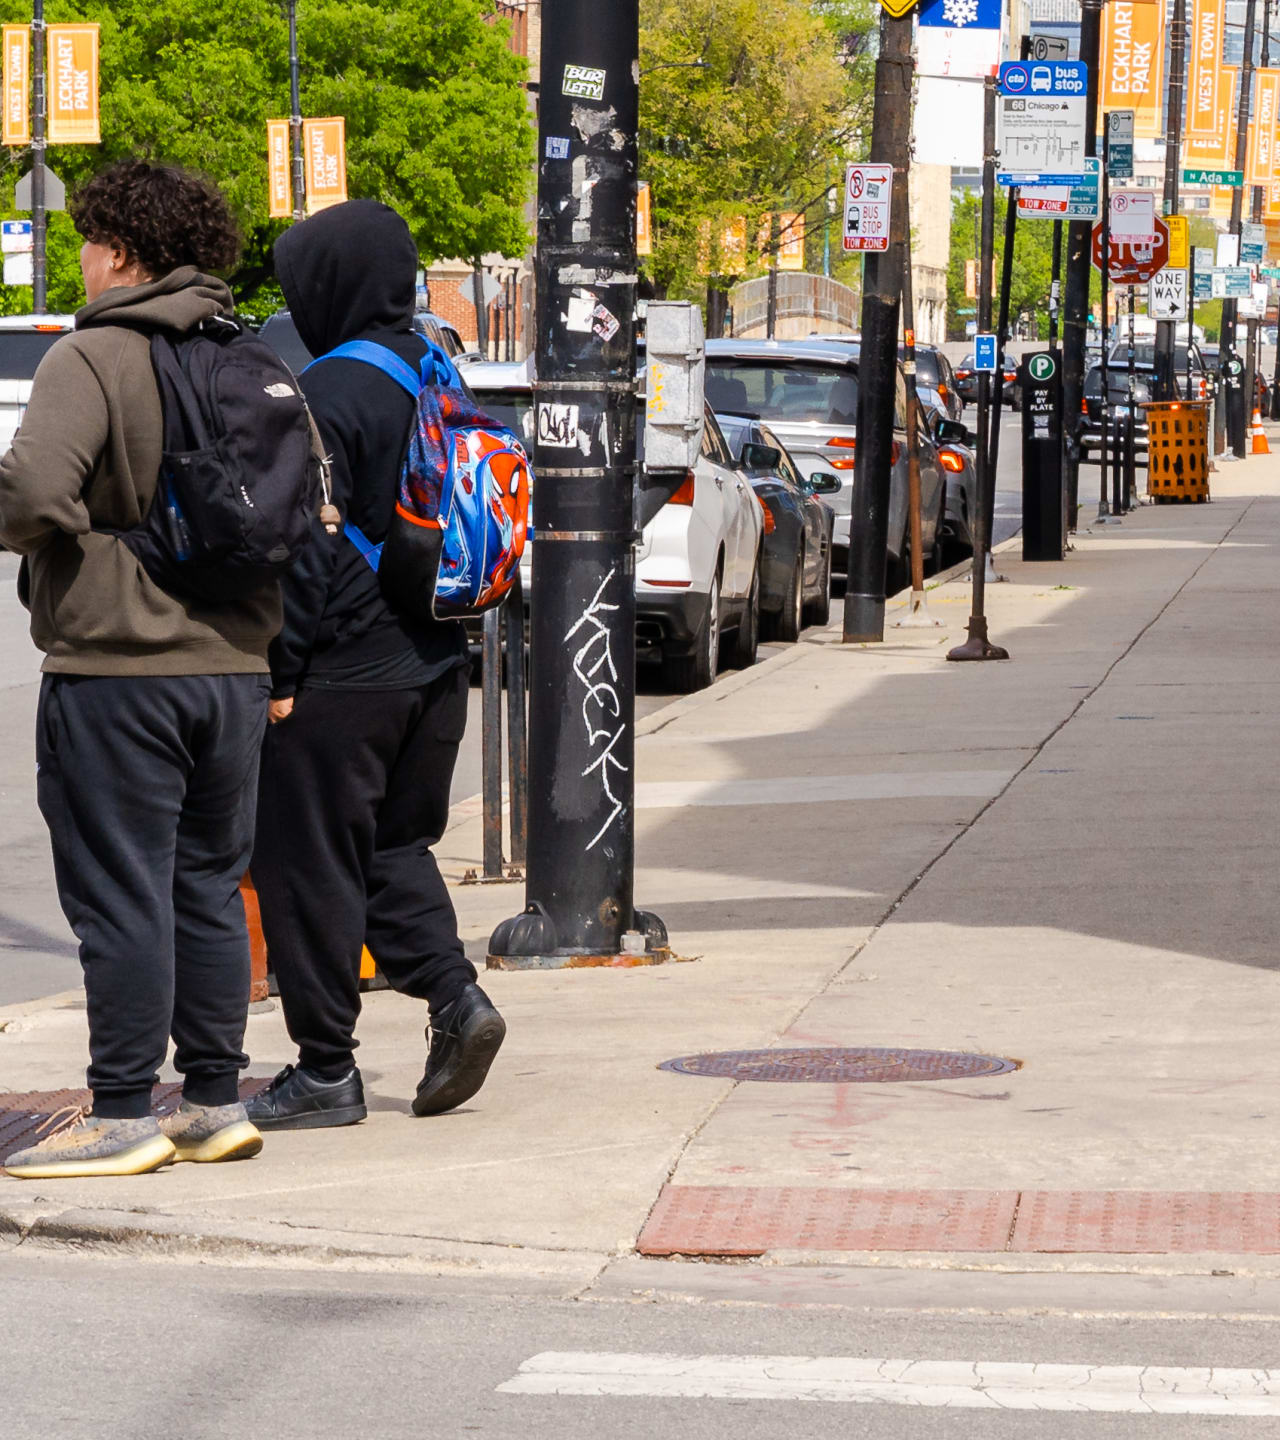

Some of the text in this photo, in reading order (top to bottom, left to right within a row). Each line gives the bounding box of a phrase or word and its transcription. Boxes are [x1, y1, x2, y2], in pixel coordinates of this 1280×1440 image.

[1200, 11, 1216, 60] TOWN
[1111, 1, 1134, 95] ECKHART
[58, 36, 73, 110] ECKHART
[1055, 66, 1079, 78] bus
[1131, 41, 1151, 94] PARK
[10, 45, 22, 123] WEST TOWN
[1008, 74, 1024, 83] cta
[1055, 79, 1083, 92] stop
[74, 69, 89, 110] PARK
[565, 80, 601, 97] LEFTY
[1198, 66, 1214, 113] WEST
[1011, 100, 1060, 111] 66 Chicago
[1258, 88, 1273, 165] WEST TOWN
[314, 129, 326, 189] ECKHART
[325, 154, 338, 188] PARK
[1199, 171, 1222, 184] Ada
[276, 170, 286, 200] WEST
[1272, 175, 1280, 204] WEST
[863, 206, 879, 219] BUS
[1024, 200, 1040, 209] TOW
[1042, 201, 1062, 211] ZONE
[862, 221, 883, 234] STOP
[846, 237, 884, 249] TOW ZONE
[1155, 273, 1183, 285] ONE
[1154, 287, 1183, 299] WAY
[1034, 389, 1049, 397] PAY
[1030, 403, 1054, 411] PLATE
